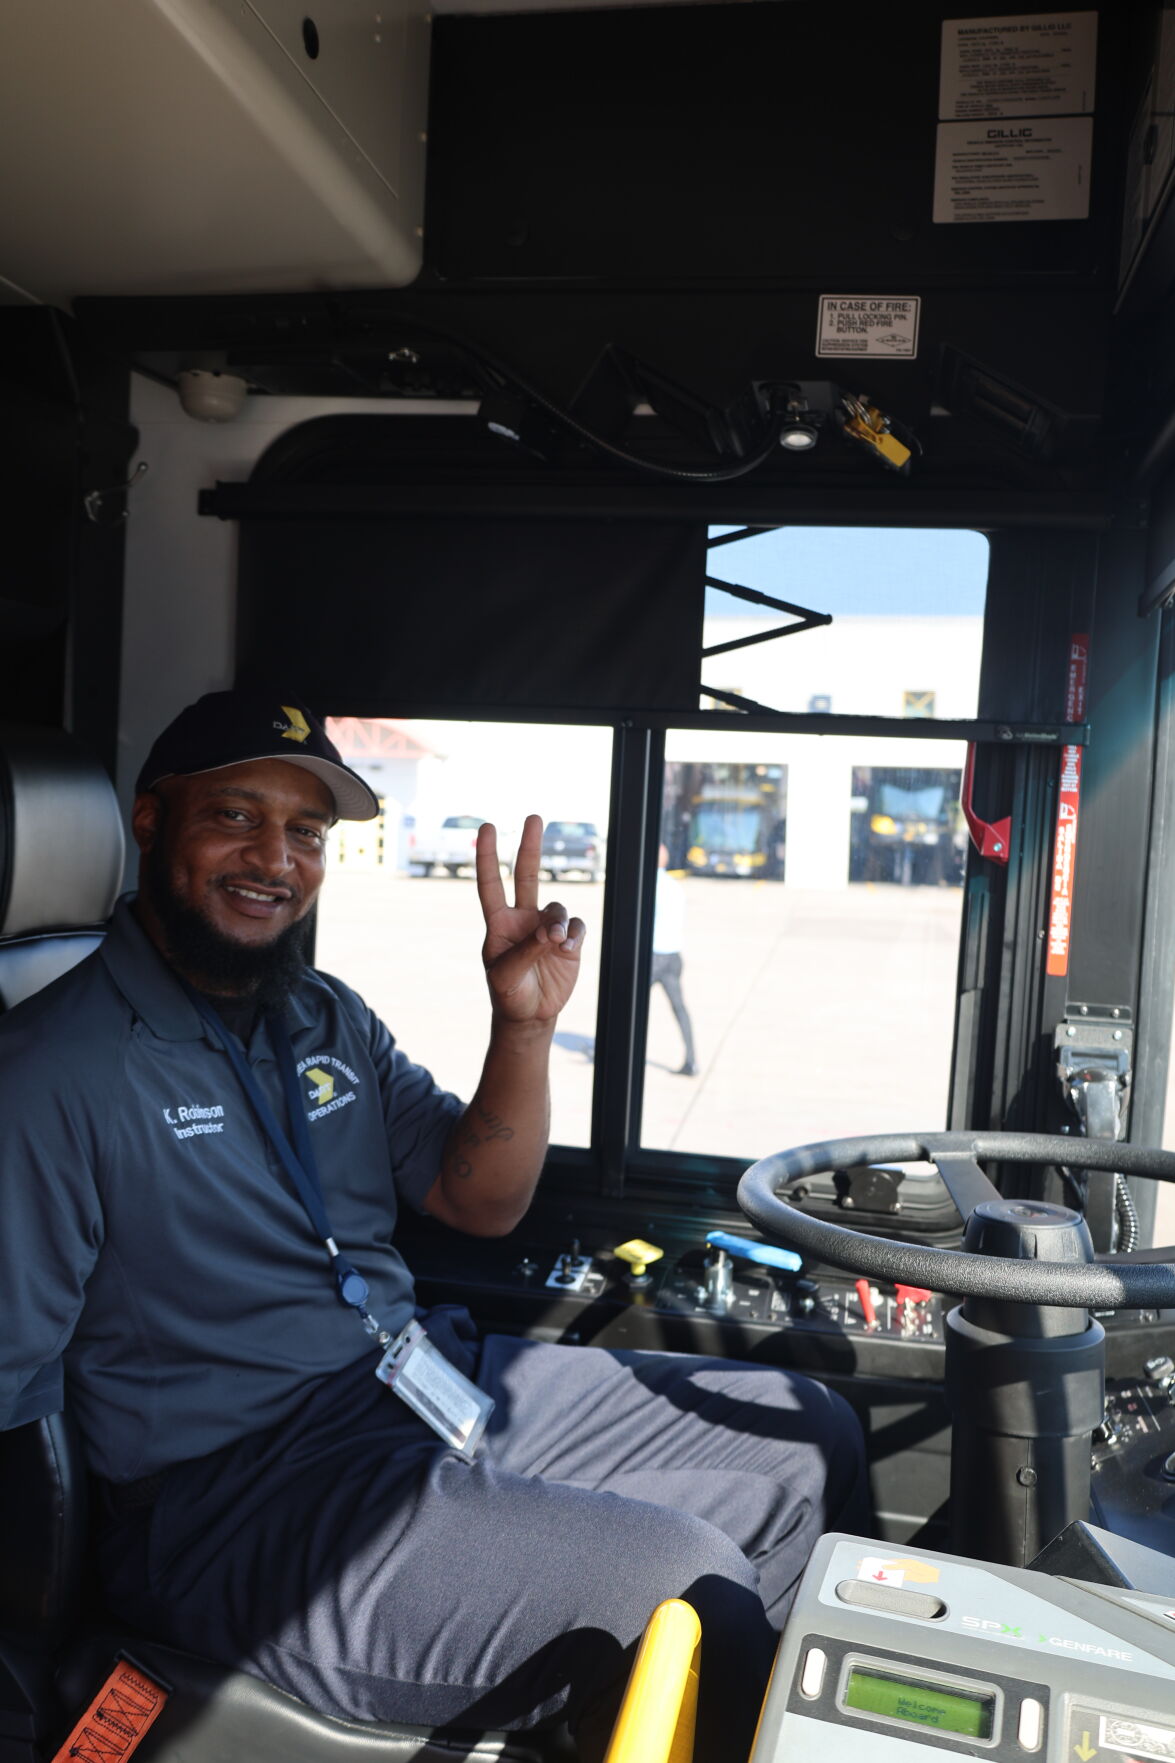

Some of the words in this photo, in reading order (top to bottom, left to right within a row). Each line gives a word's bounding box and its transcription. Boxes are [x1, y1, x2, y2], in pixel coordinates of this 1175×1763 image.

[957, 25, 1018, 36] MANUFACTURED
[1020, 25, 1030, 33] BY
[827, 301, 837, 311] IN
[840, 301, 867, 312] CASE
[869, 302, 883, 312] OF
[885, 302, 912, 312] FIRE:
[305, 1055, 331, 1066] RAPID
[331, 1057, 361, 1085] TRANSIT
[307, 1091, 357, 1122] OPERATIONS
[163, 1108, 178, 1125] K.
[173, 1122, 225, 1140] Instructor
[961, 1616, 1023, 1638] SPX
[1049, 1637, 1134, 1662] GENFARE
[898, 1697, 946, 1714] Welcome
[896, 1706, 939, 1723] Aboard
